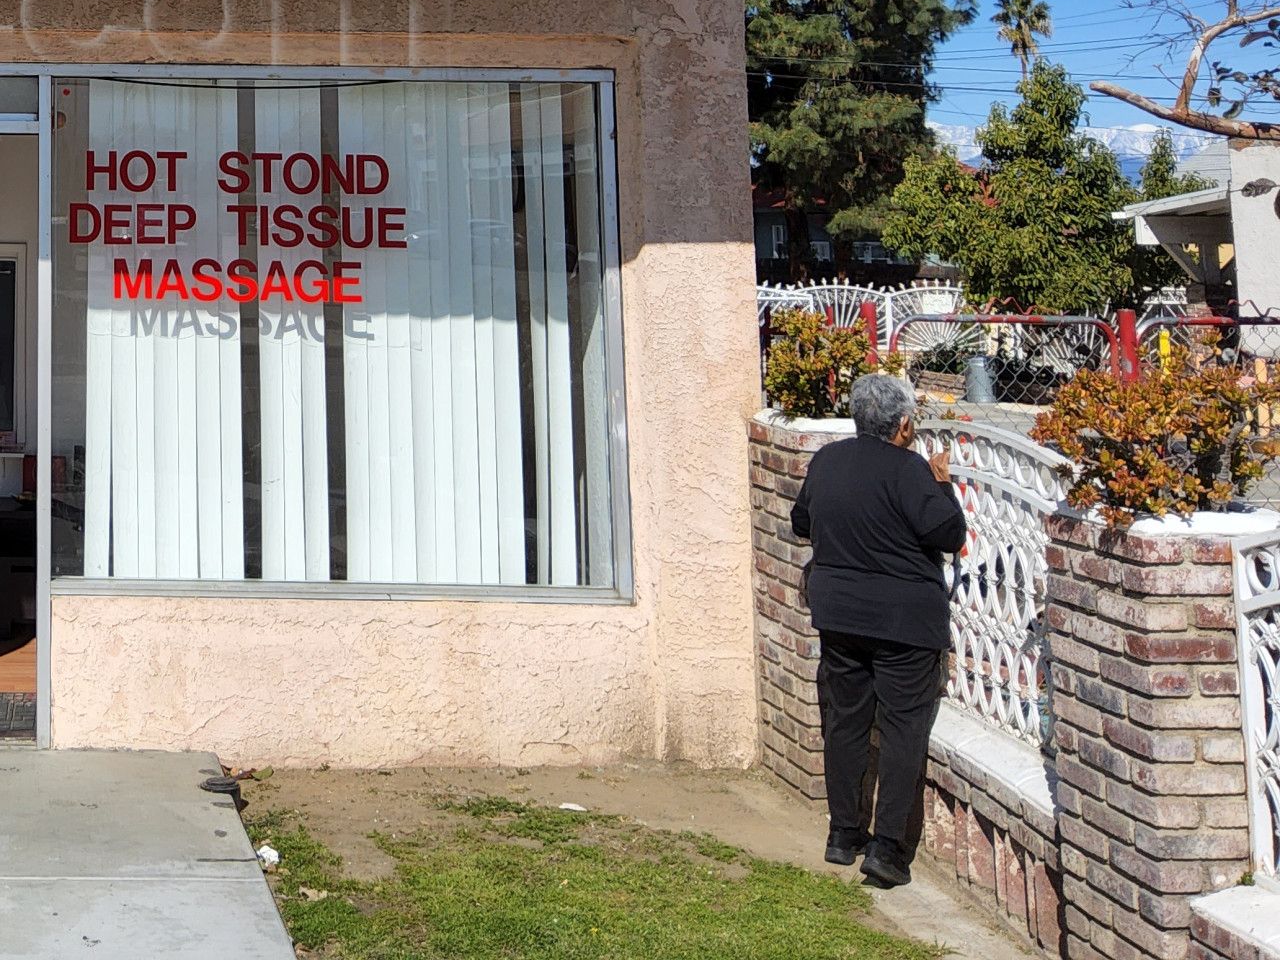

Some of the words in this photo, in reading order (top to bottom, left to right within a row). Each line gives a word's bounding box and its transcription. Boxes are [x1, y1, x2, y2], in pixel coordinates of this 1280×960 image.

[86, 150, 188, 194] HOT
[218, 151, 390, 196] STOND
[69, 202, 197, 245] DEEP
[227, 204, 408, 250] TISSUE
[112, 257, 364, 304] MASSAGE
